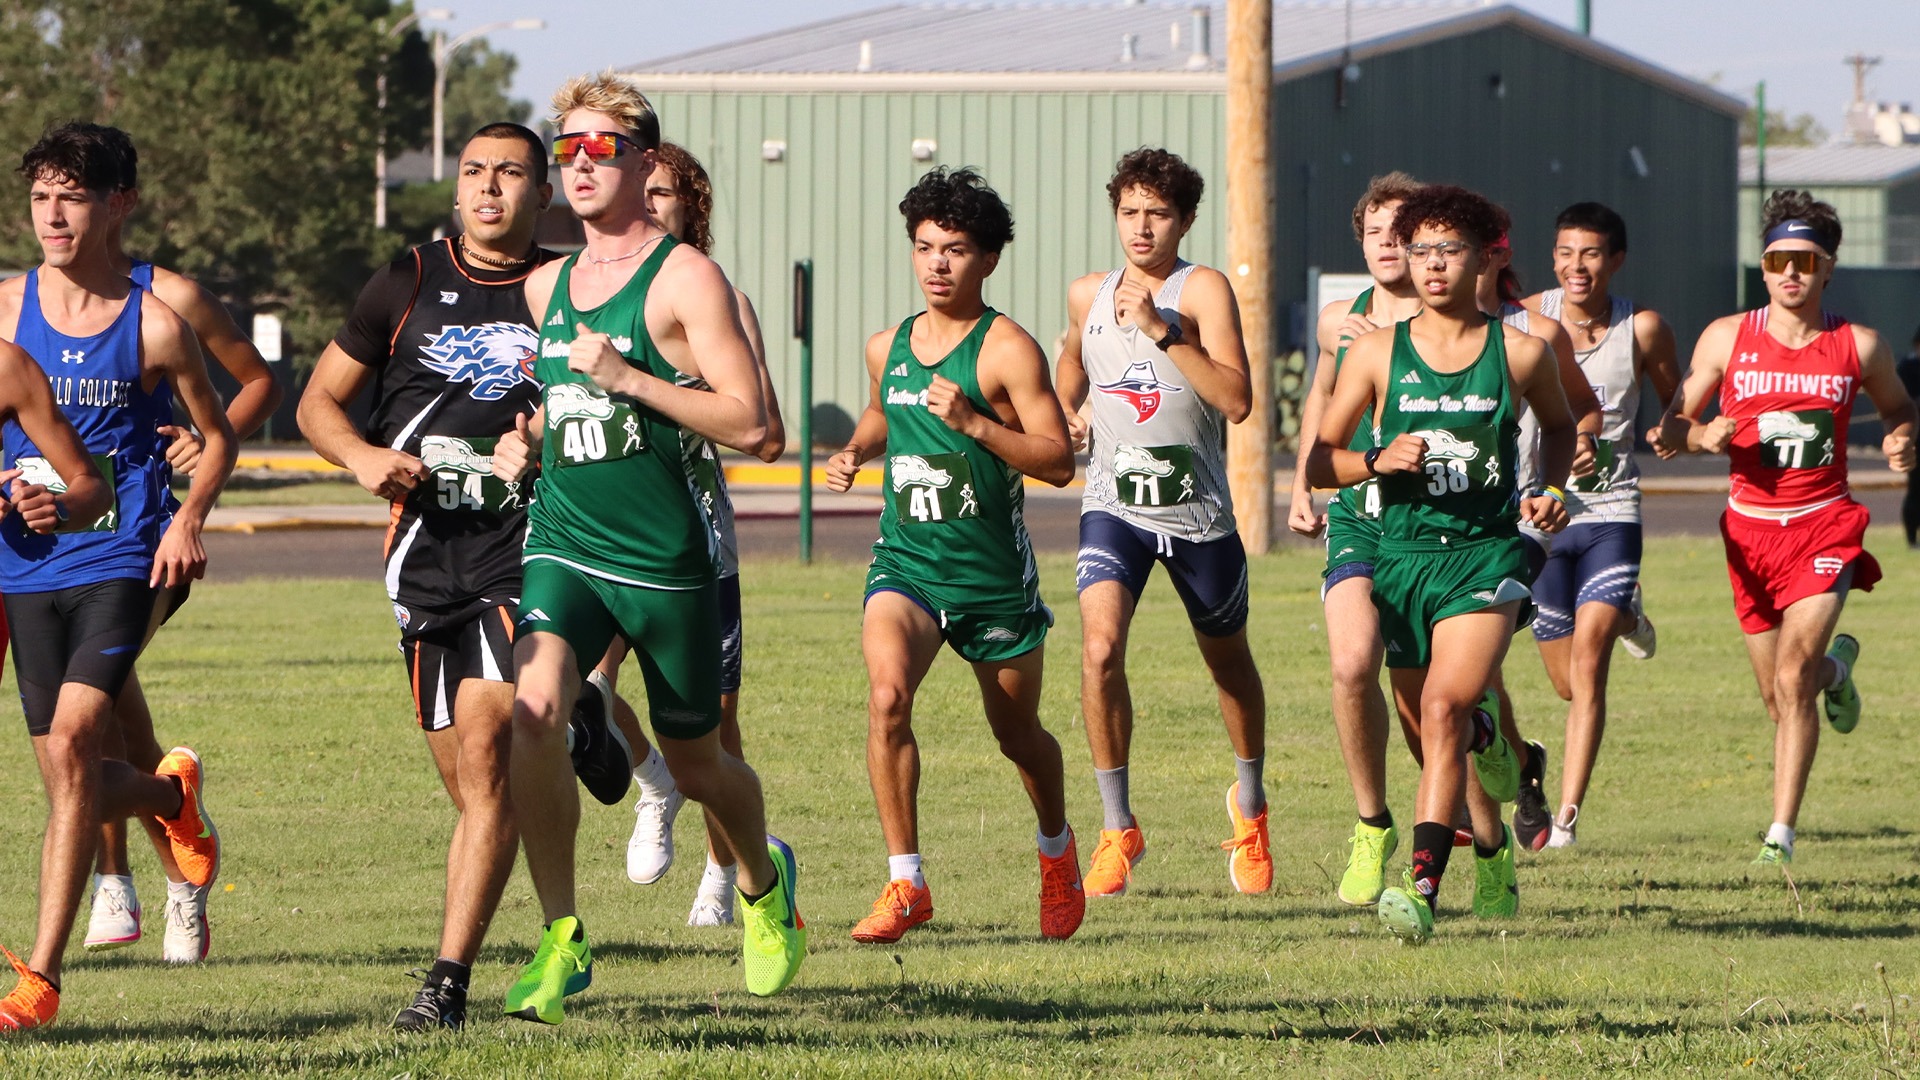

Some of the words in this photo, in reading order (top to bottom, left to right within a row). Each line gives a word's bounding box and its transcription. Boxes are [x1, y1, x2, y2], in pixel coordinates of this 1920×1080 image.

[50, 376, 72, 406] LO
[78, 378, 131, 408] COLLEGE
[1398, 394, 1439, 412] Eastern
[1439, 395, 1463, 412] New
[1463, 395, 1498, 412] Mexico
[1734, 371, 1852, 405] SOUTHWEST
[563, 419, 607, 463] 40
[1774, 438, 1804, 468] 77
[437, 472, 484, 511] 54
[1128, 475, 1160, 506] 71
[1425, 459, 1469, 497] 38
[909, 487, 943, 522] 41
